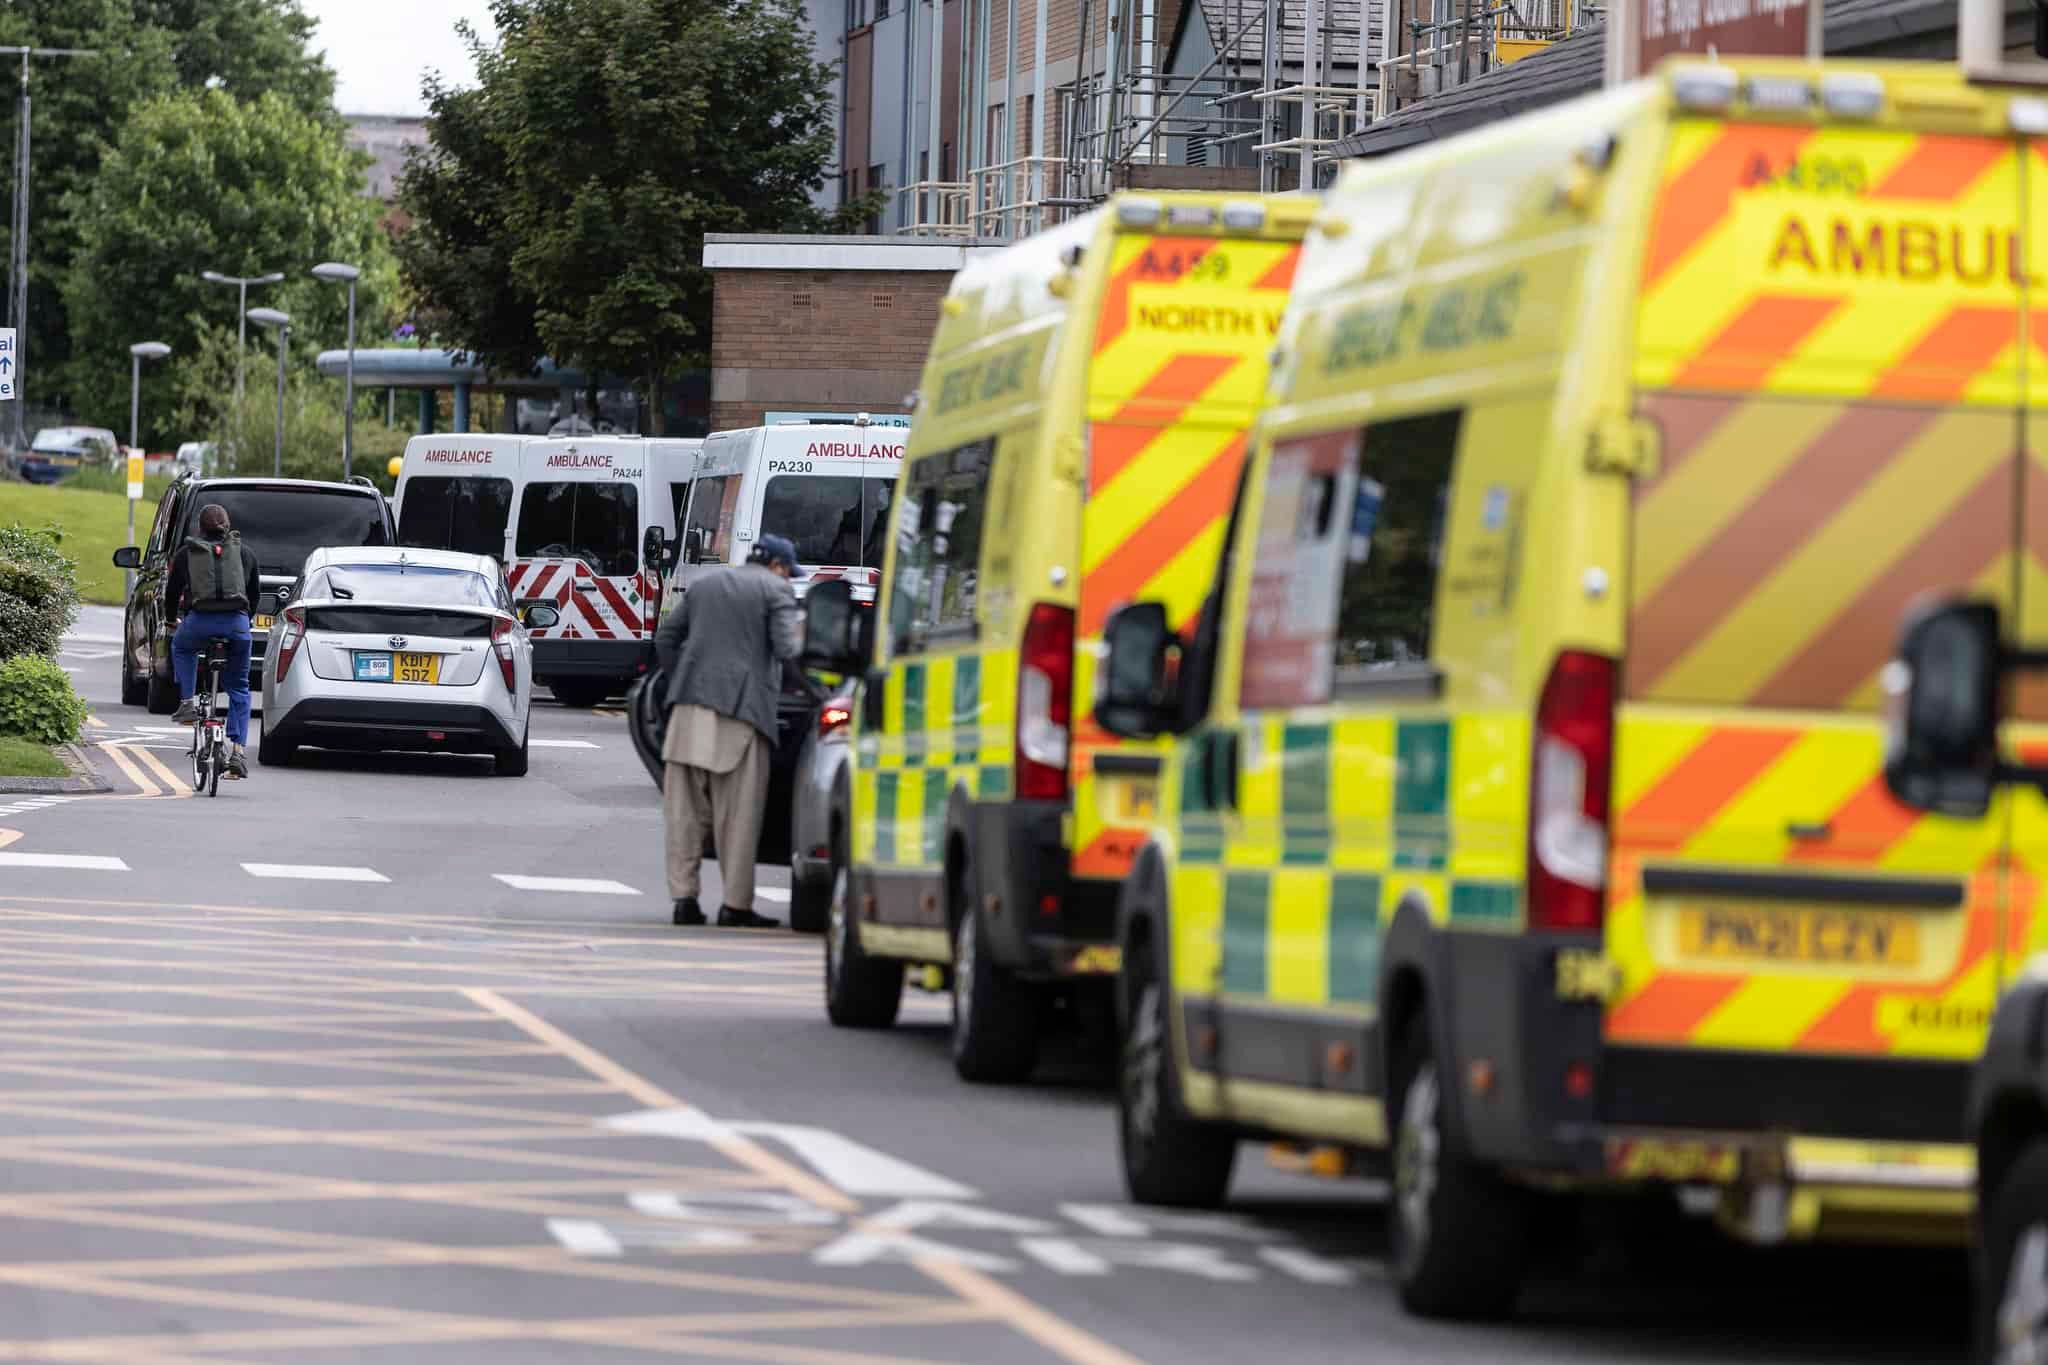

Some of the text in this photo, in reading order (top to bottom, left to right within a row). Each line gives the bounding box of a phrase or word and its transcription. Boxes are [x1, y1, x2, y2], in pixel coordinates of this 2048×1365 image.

[1137, 304, 1256, 333] NORTH
[424, 449, 493, 464] AMBULANCE
[546, 455, 613, 468] AMBULANCE
[612, 467, 643, 479] PA244
[768, 460, 813, 473] PA230
[400, 653, 432, 668] KD17
[402, 669, 430, 682] SDZ
